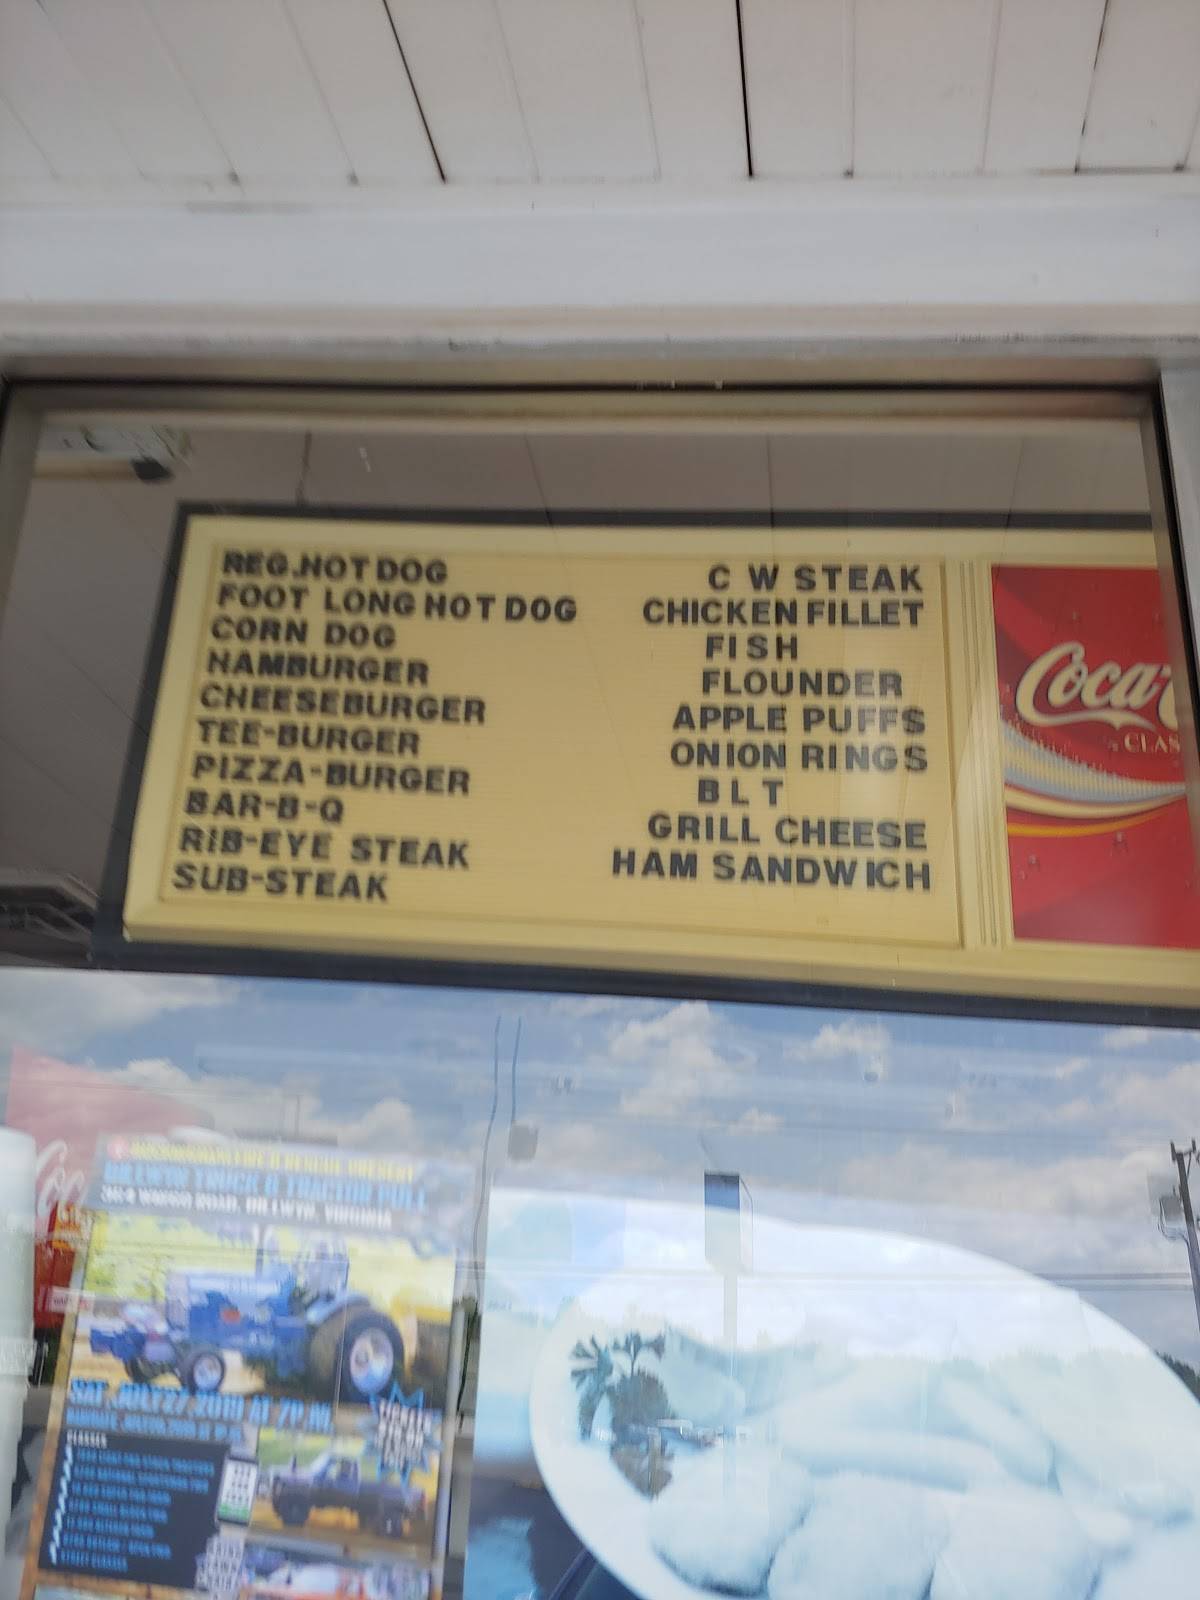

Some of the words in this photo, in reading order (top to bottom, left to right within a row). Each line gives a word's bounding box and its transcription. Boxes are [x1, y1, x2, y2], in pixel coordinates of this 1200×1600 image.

[377, 557, 447, 585] DOG
[795, 564, 922, 592] STEAK
[218, 583, 308, 610] FOOT
[325, 588, 415, 616] LONG
[425, 593, 496, 620] HOT
[505, 595, 576, 623] DOG
[643, 598, 797, 627] CHICKEN
[807, 600, 923, 627] FILLET
[211, 615, 308, 644] CORN
[324, 621, 395, 649] DOG
[706, 633, 797, 662] FISH
[207, 650, 429, 686] HAMBURGER
[702, 668, 902, 697] FLOUNDER
[200, 682, 485, 724] CHEESEBURGER
[673, 704, 787, 733] APPLE
[803, 705, 925, 736] PUFFS
[198, 718, 420, 756] TEE-BURGER
[671, 740, 786, 769] ONION
[802, 743, 927, 772] RINGS
[192, 753, 470, 795] PIZZA-BURGER
[185, 789, 344, 824] BAR-B-Q
[179, 825, 332, 861] RIB-EYE
[351, 835, 469, 869] STEAK
[648, 812, 760, 844] GRILL
[775, 816, 927, 850] CHEESE
[174, 862, 387, 901] SUB-STEAK
[613, 848, 697, 880] HAM
[713, 852, 930, 891] SANDWICH
